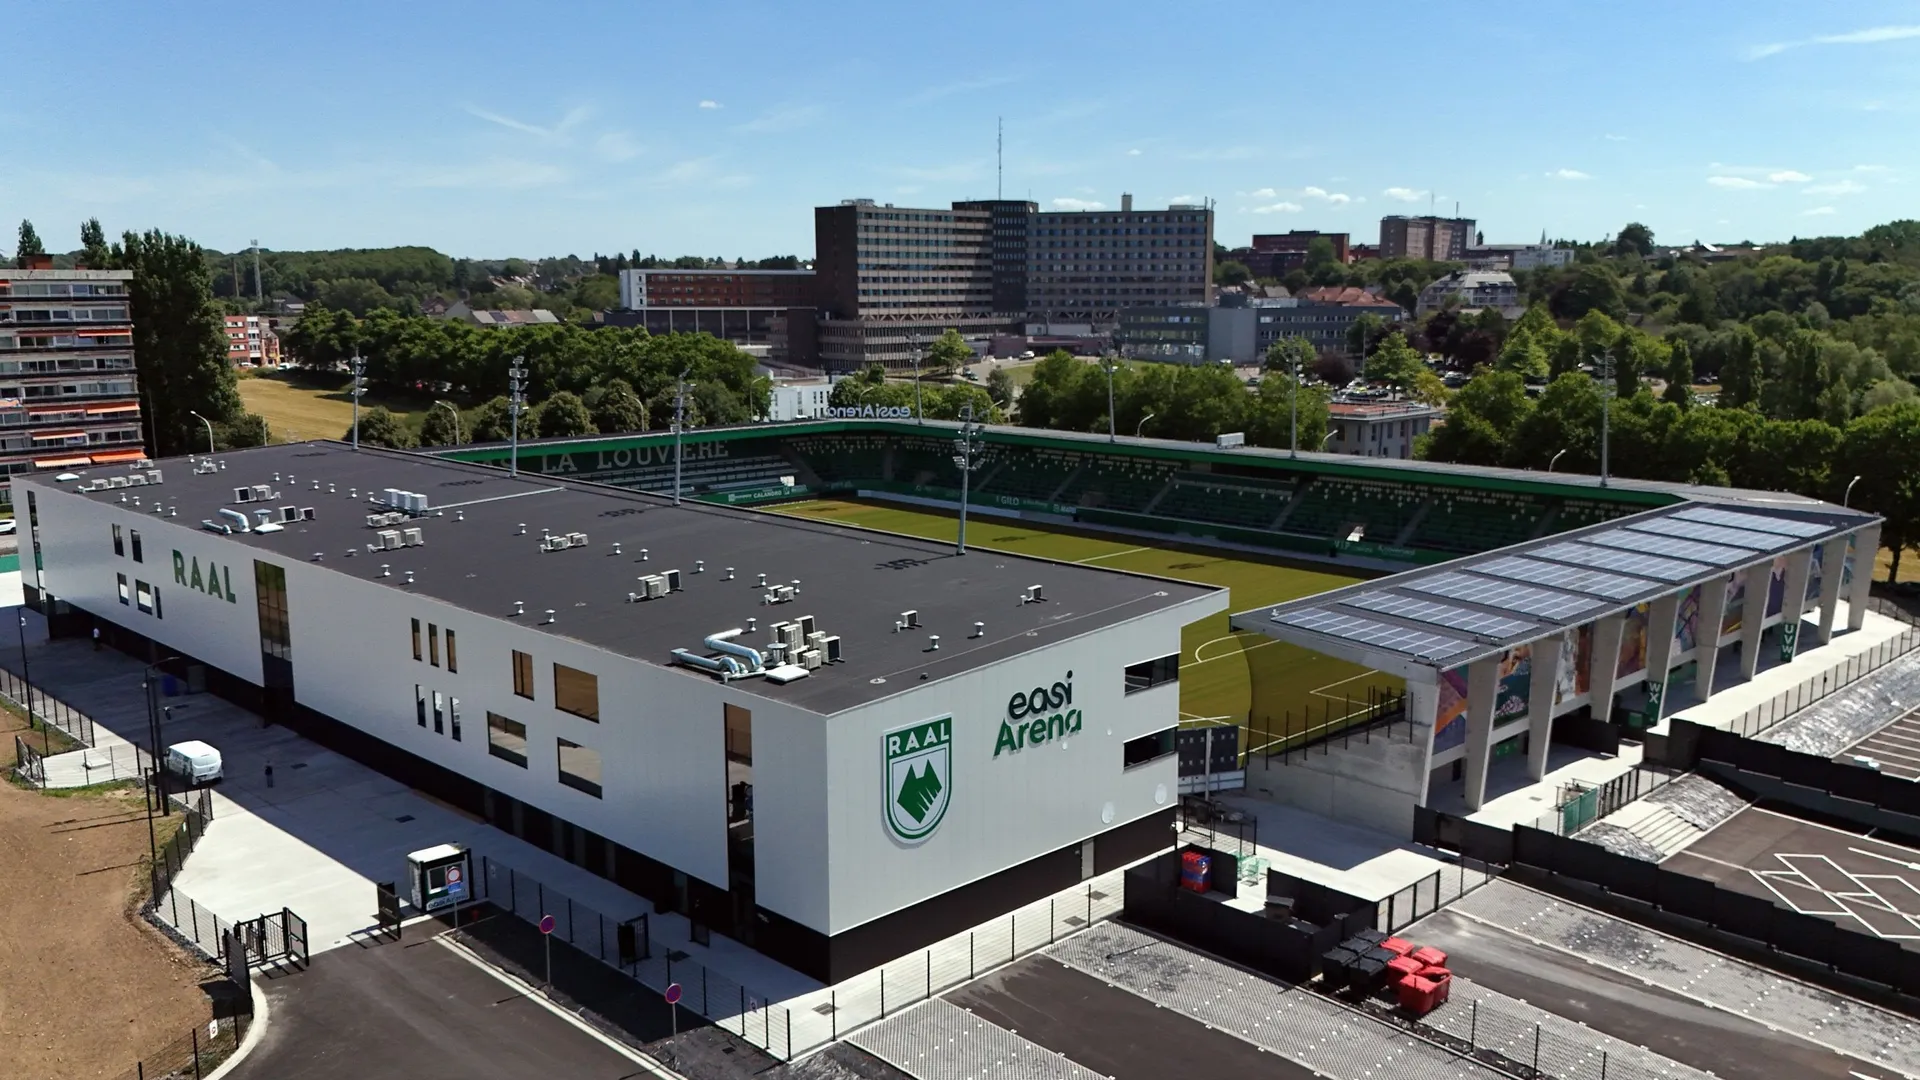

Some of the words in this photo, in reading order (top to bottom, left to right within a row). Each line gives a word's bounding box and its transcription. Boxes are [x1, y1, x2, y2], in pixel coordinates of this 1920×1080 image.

[540, 453, 578, 473] LA
[172, 548, 237, 605] RAAL
[1008, 670, 1073, 720] easi
[888, 722, 950, 756] RAAL
[993, 718, 1082, 757] Arena
